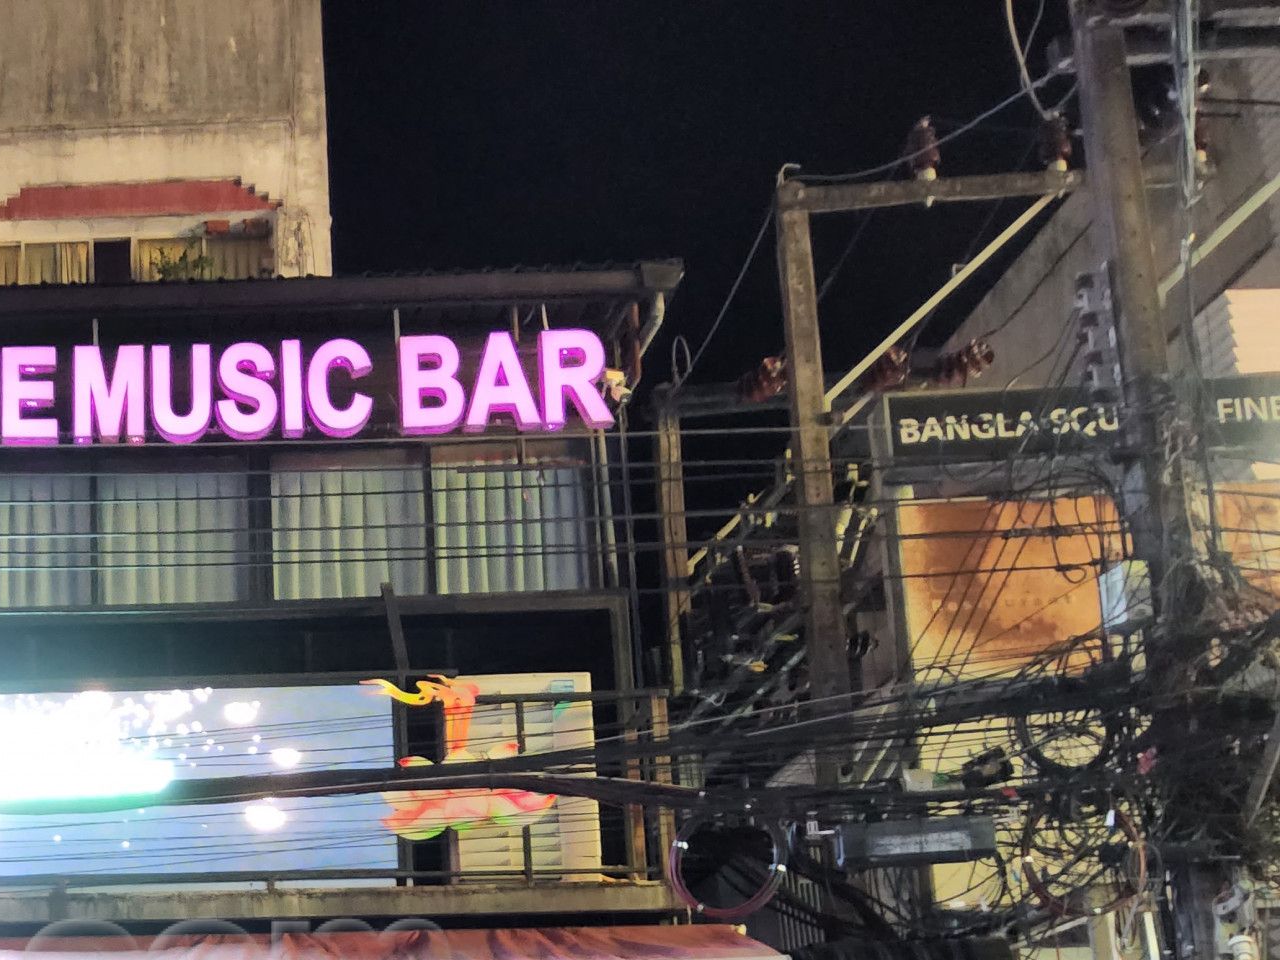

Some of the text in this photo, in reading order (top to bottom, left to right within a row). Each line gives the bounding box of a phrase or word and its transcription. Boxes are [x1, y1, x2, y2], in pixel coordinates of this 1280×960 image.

[72, 338, 376, 445] MUSIC
[398, 327, 617, 434] BAR
[898, 409, 1040, 445] BANGLA
